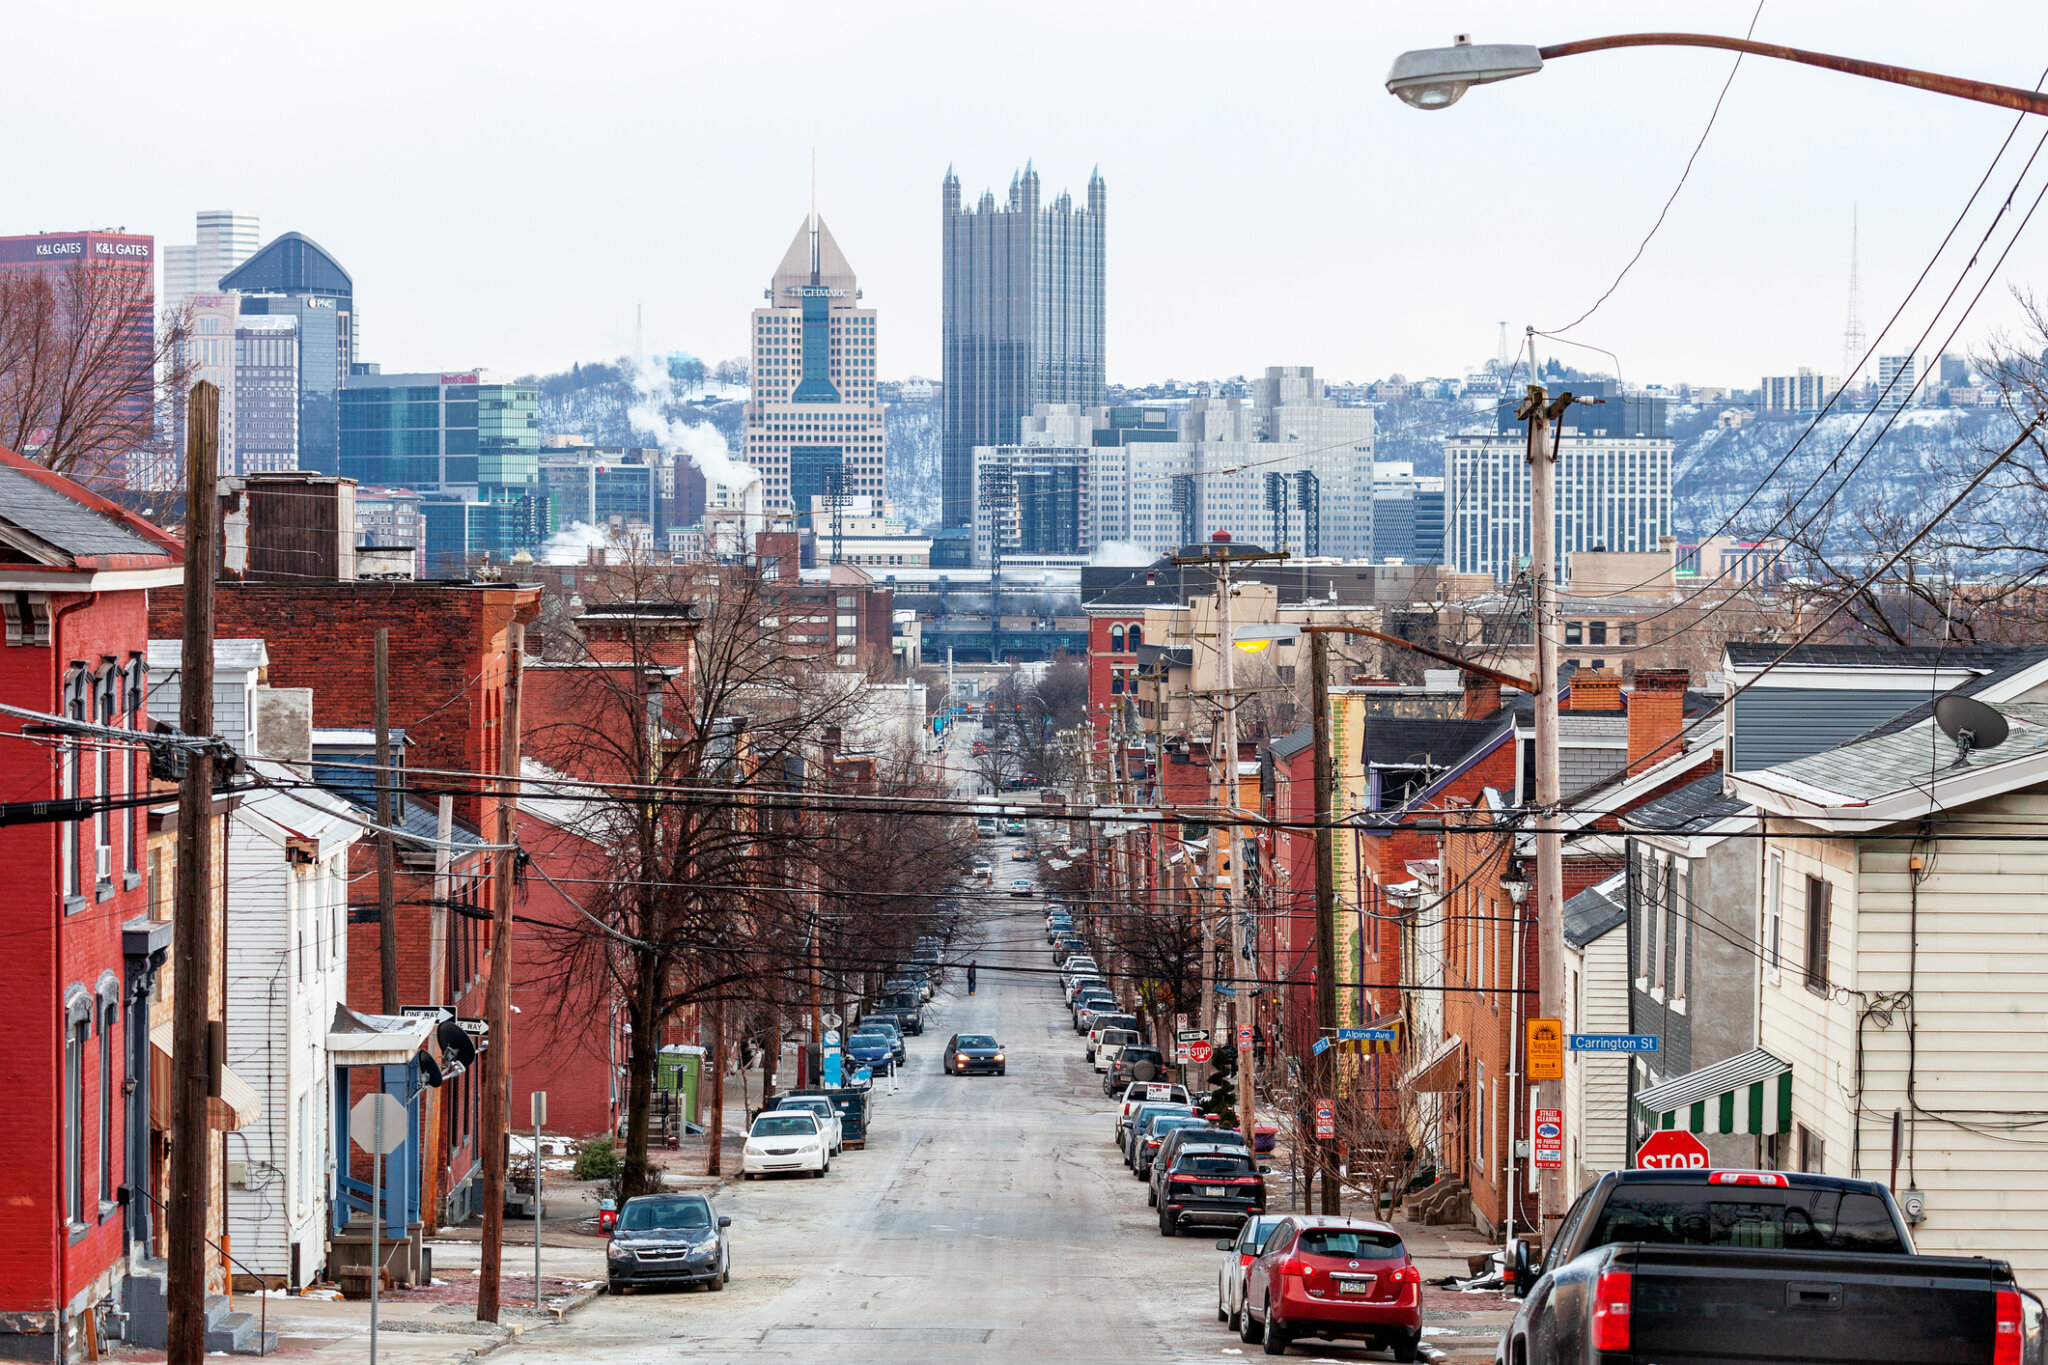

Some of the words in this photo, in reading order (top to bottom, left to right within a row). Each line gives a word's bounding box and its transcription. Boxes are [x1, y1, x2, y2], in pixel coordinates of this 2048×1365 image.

[37, 245, 52, 255] K&L
[53, 243, 81, 254] GATES
[96, 243, 114, 254] K&L
[116, 244, 148, 256] GATES
[792, 287, 846, 298] HIGHMARK
[317, 299, 332, 308] PNC
[1345, 1031, 1370, 1039] Alpine
[1375, 1031, 1390, 1039] Ave
[1576, 1037, 1636, 1050] Carrington
[1641, 1038, 1653, 1049] St
[1191, 1047, 1210, 1056] STOP
[1642, 1153, 1705, 1169] STOP
